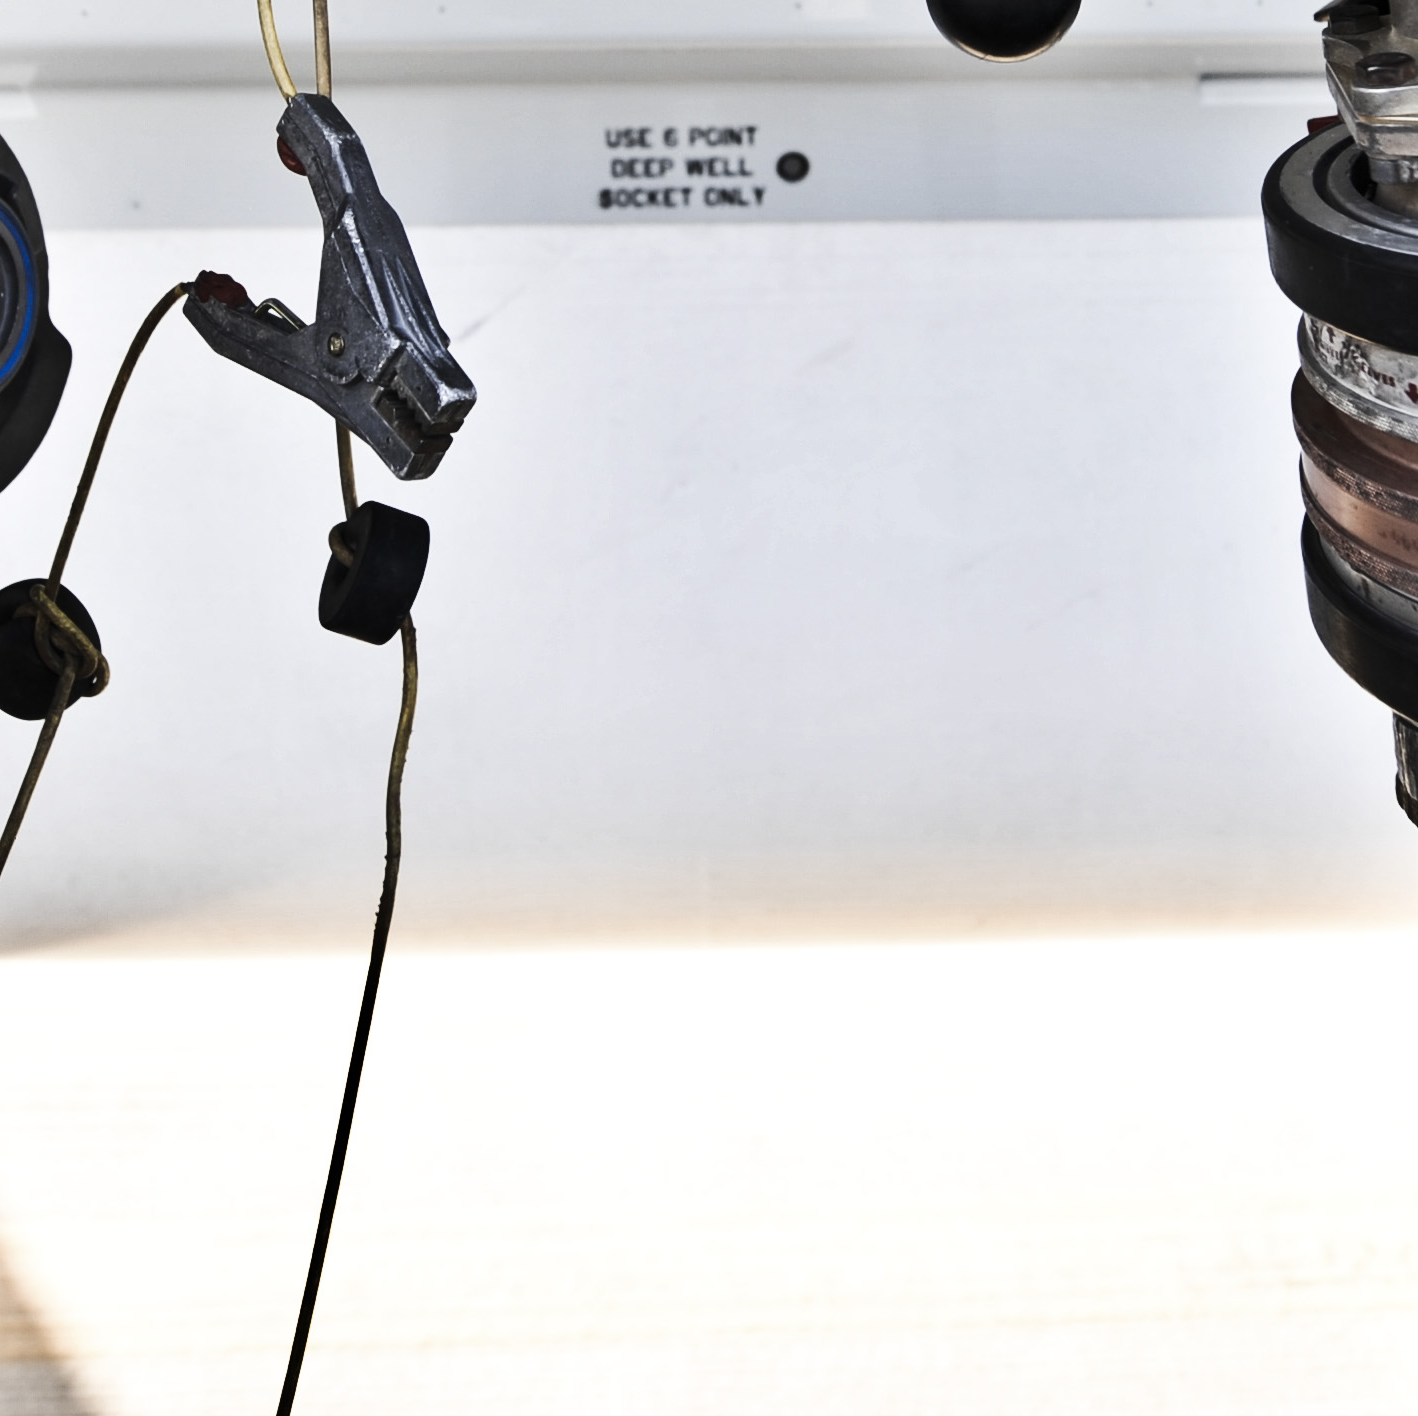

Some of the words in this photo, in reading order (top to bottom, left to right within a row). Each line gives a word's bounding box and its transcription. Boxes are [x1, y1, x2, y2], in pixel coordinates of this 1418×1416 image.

[605, 127, 651, 148] USE
[664, 127, 678, 147] 6
[689, 126, 757, 146] POINT
[611, 158, 673, 178] DEEP
[686, 158, 752, 177] WELL
[598, 188, 691, 208] SOCKET
[704, 187, 765, 207] ONLY
